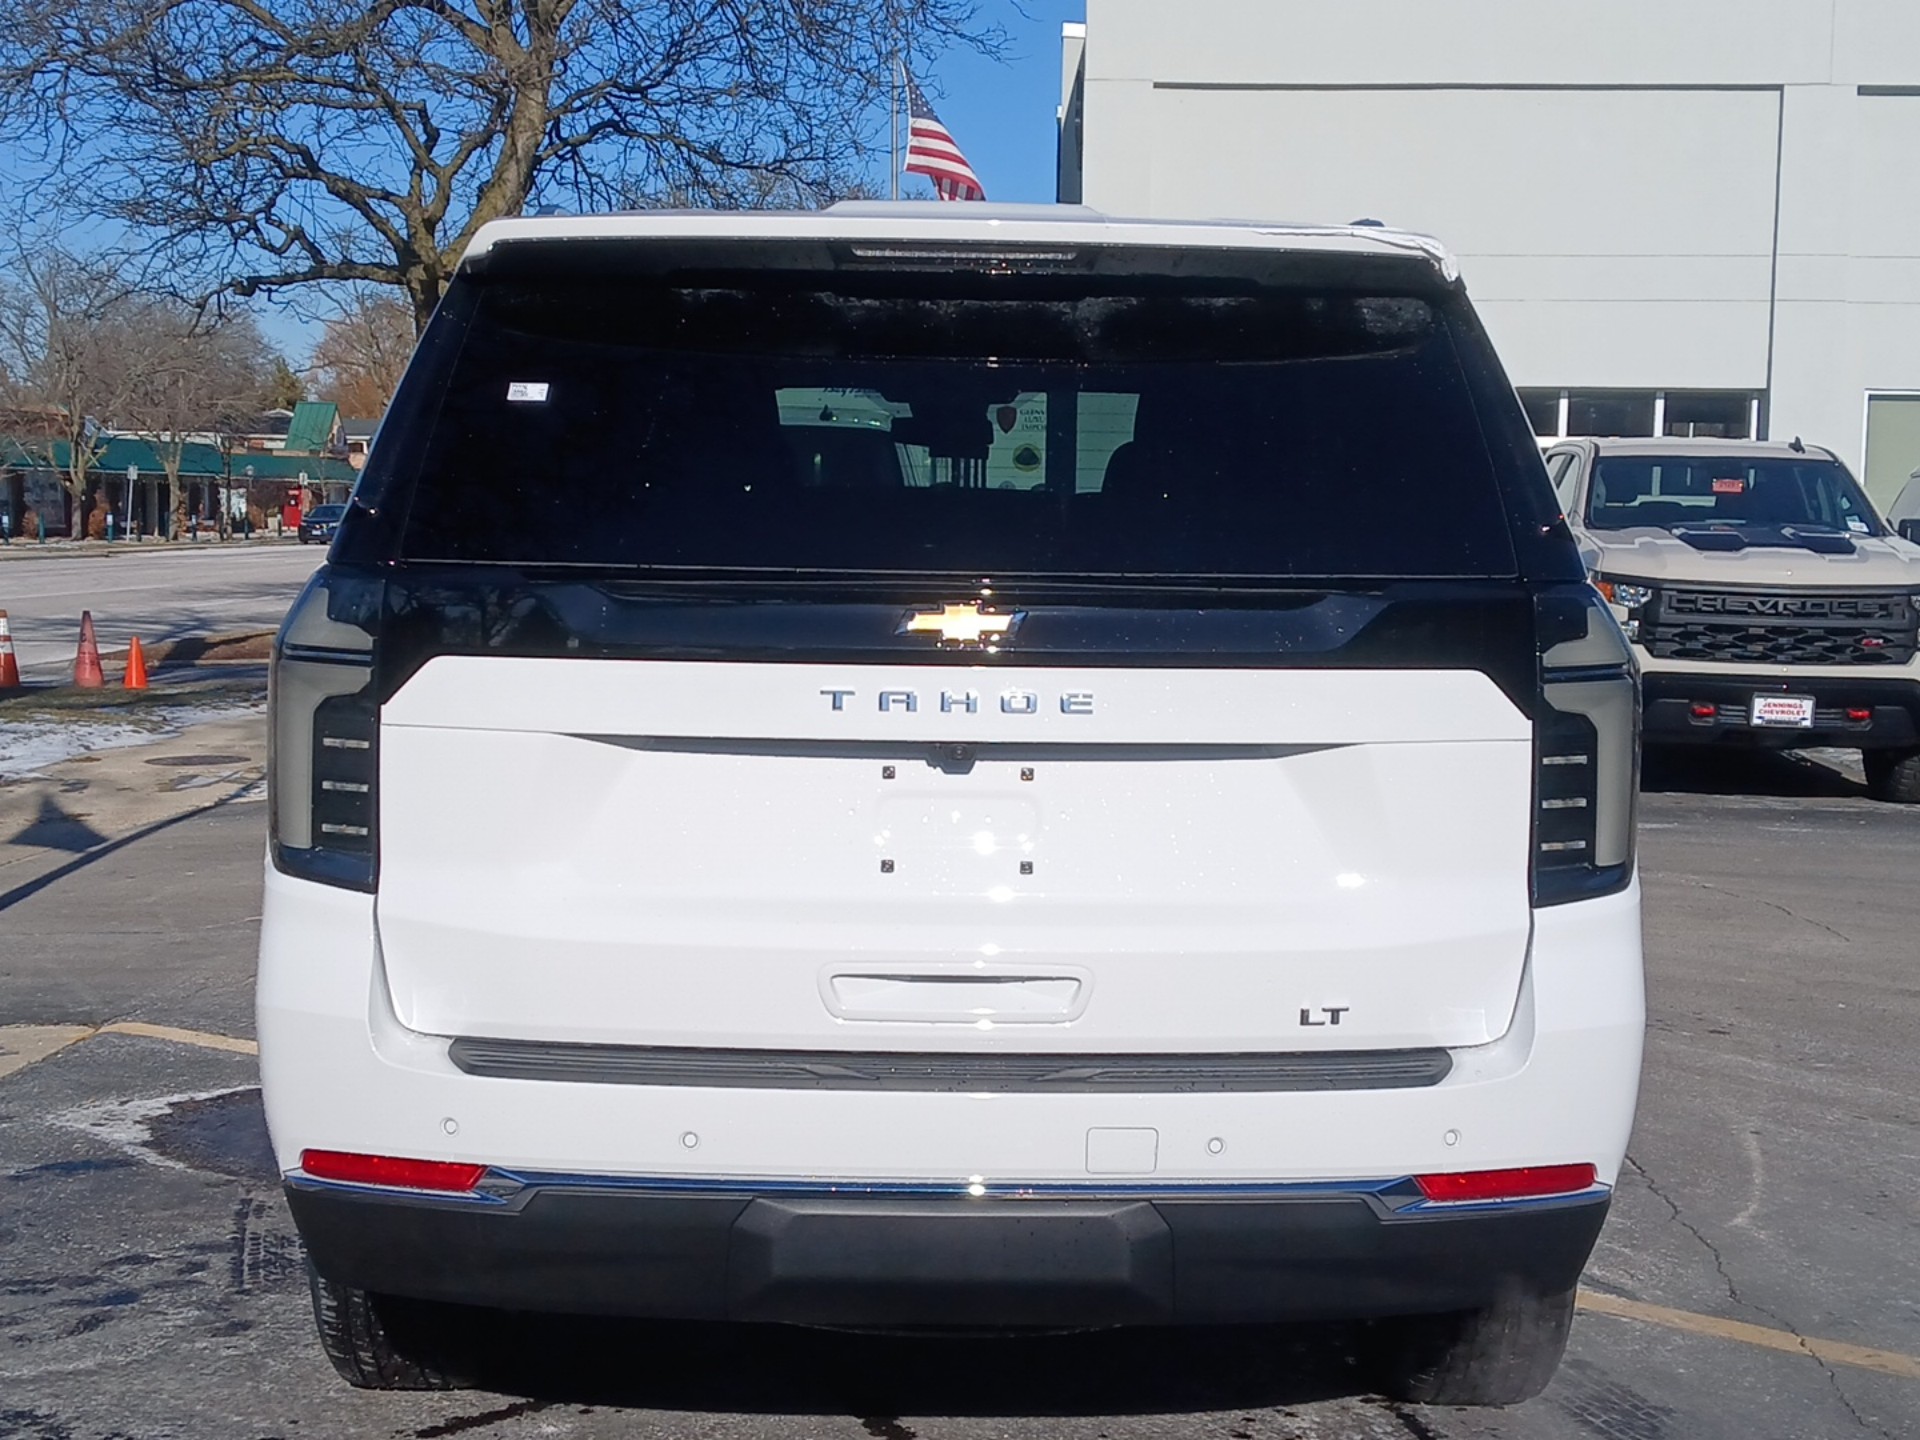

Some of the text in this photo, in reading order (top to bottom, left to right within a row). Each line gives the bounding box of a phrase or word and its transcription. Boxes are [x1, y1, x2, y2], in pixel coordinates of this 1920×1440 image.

[1670, 595, 1907, 619] CHEVROLET
[820, 690, 1093, 714] TAHOE
[1300, 1008, 1349, 1026] LT
